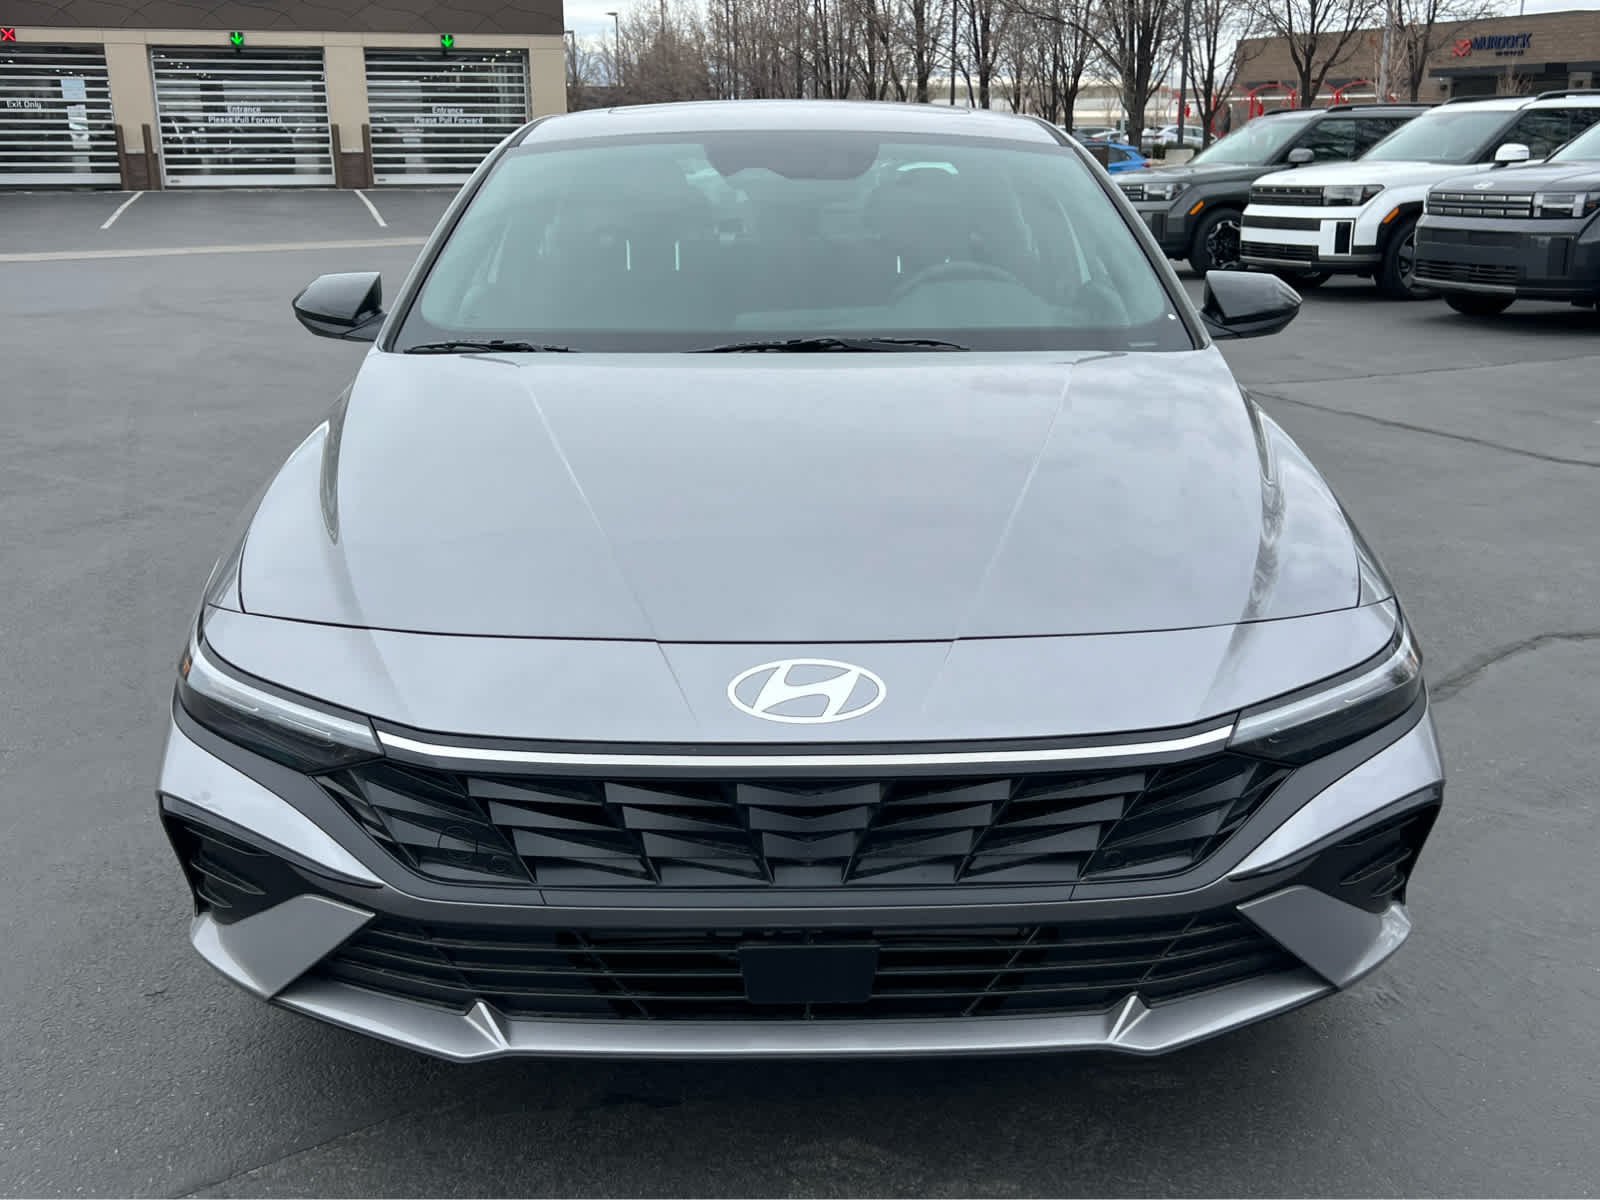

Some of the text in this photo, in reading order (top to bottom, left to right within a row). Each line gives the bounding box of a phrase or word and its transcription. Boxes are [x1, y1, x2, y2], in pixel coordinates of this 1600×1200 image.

[6, 100, 42, 111] Exit Only
[226, 104, 261, 113] Entrance
[432, 105, 464, 114] Entrance
[207, 114, 282, 124] Please Pull Forward
[414, 116, 483, 124] Please Pull Forward
